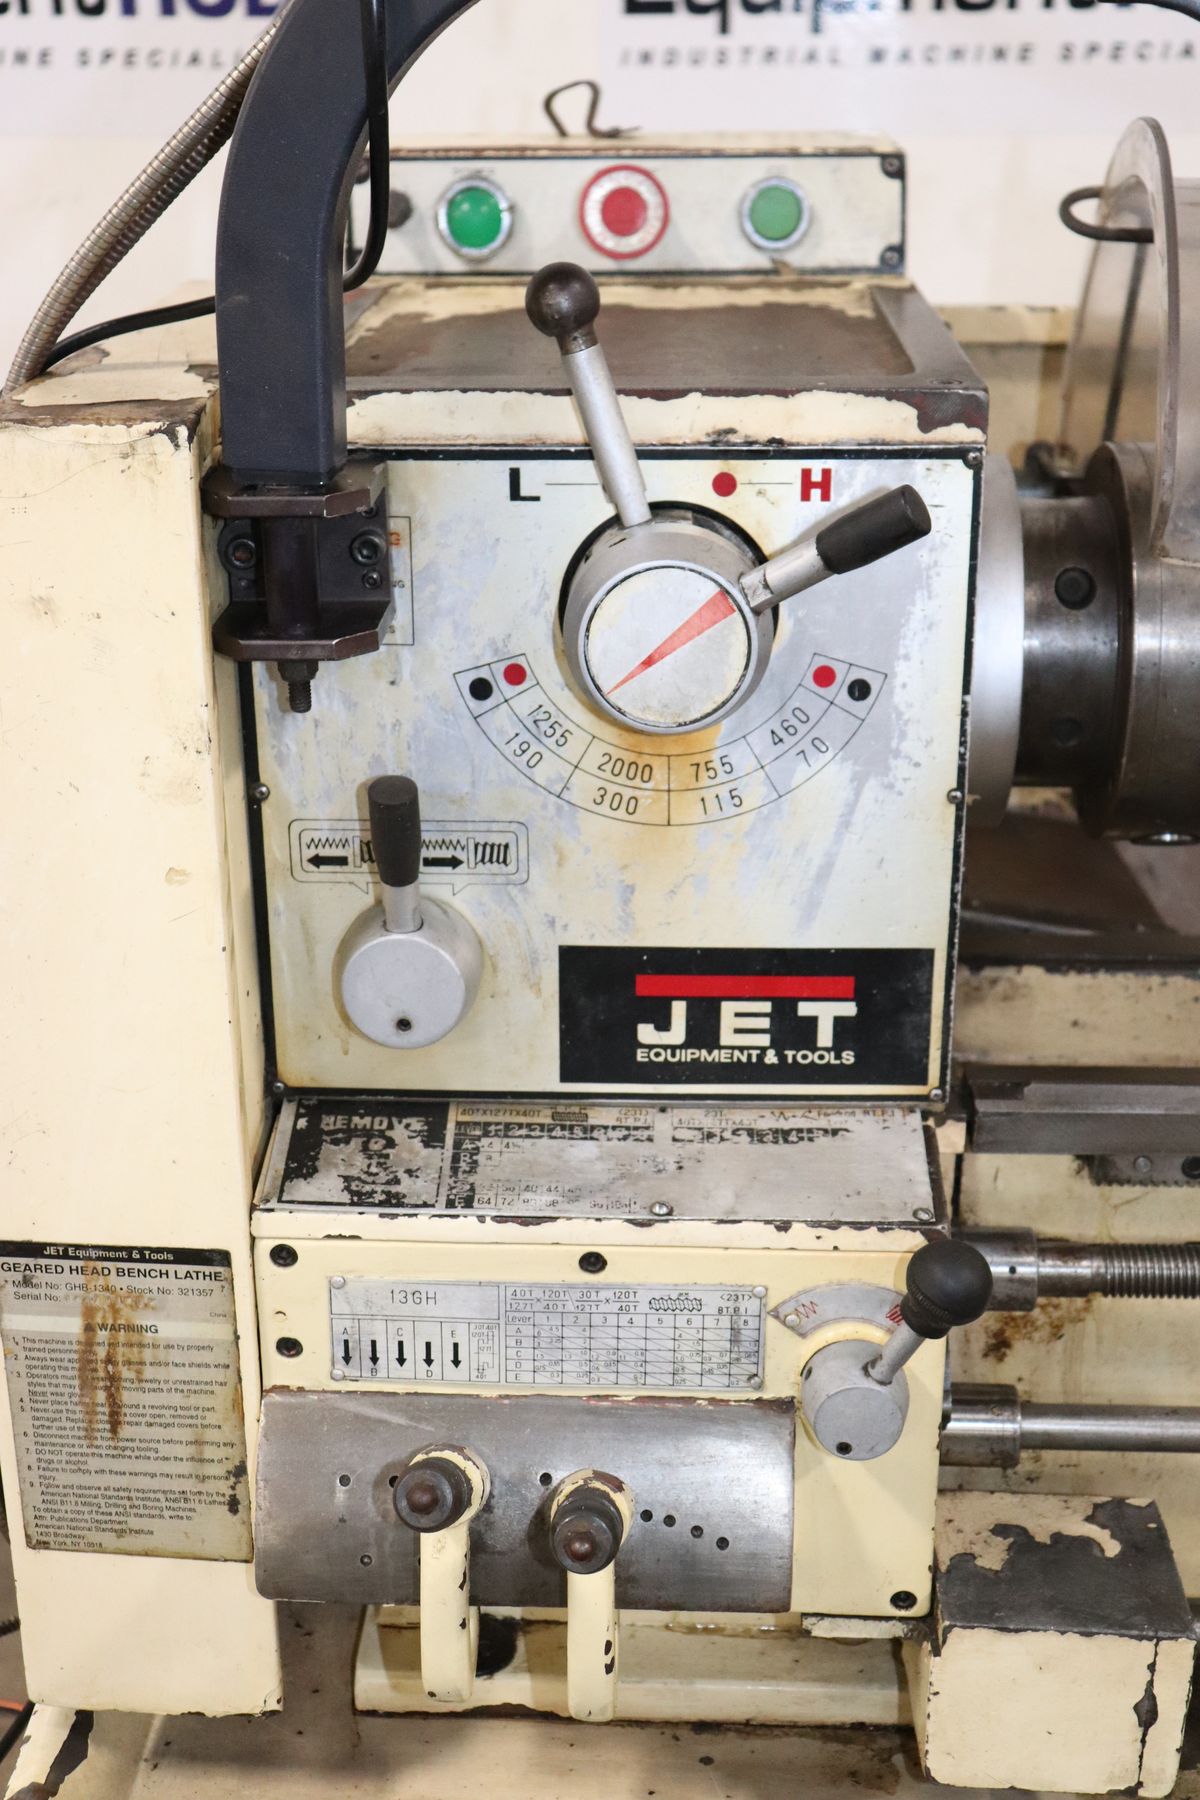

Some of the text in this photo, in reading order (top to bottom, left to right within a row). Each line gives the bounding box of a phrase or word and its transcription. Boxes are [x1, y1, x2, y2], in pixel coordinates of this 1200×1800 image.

[509, 468, 832, 502] L H
[529, 704, 574, 748] 1255
[770, 706, 812, 748] 460
[504, 732, 543, 769] 190
[798, 739, 830, 769] 70
[597, 752, 653, 781] 2000
[690, 755, 734, 781] 755
[592, 786, 639, 815] 300
[699, 788, 744, 816] 115
[636, 1000, 858, 1048] JET
[636, 1048, 856, 1066] EQUIPMENT & TOOLS
[44, 1246, 174, 1261] JET Equipment & Tools
[1, 1262, 224, 1282] GEARED HEAD BENCH LATHE
[12, 1280, 42, 1289] Model
[65, 1283, 117, 1292] GHB-1340
[127, 1285, 154, 1295] Stock
[157, 1287, 174, 1296] No:
[178, 1288, 214, 1297] 321357
[13, 1291, 61, 1302] Serial No:
[511, 1289, 638, 1300] 40T 120T 30T 120T
[391, 1289, 437, 1306] 13GH
[544, 1303, 566, 1311] 40T
[618, 1305, 638, 1313] 40T
[97, 1323, 159, 1334] WARNING
[508, 1315, 532, 1323] Lever
[574, 1316, 580, 1324] 2
[602, 1316, 608, 1325] 3
[627, 1317, 634, 1325] 4
[687, 1318, 693, 1326] 6
[714, 1318, 720, 1327] 7
[743, 1319, 749, 1327] 8
[343, 1327, 349, 1336] A
[397, 1328, 404, 1337] C
[38, 1337, 64, 1345] machine
[187, 1343, 214, 1353] properly
[515, 1350, 522, 1358] C
[371, 1368, 378, 1377] B
[426, 1370, 433, 1378] D
[515, 1372, 521, 1380] E
[34, 1430, 69, 1439] Disconnect
